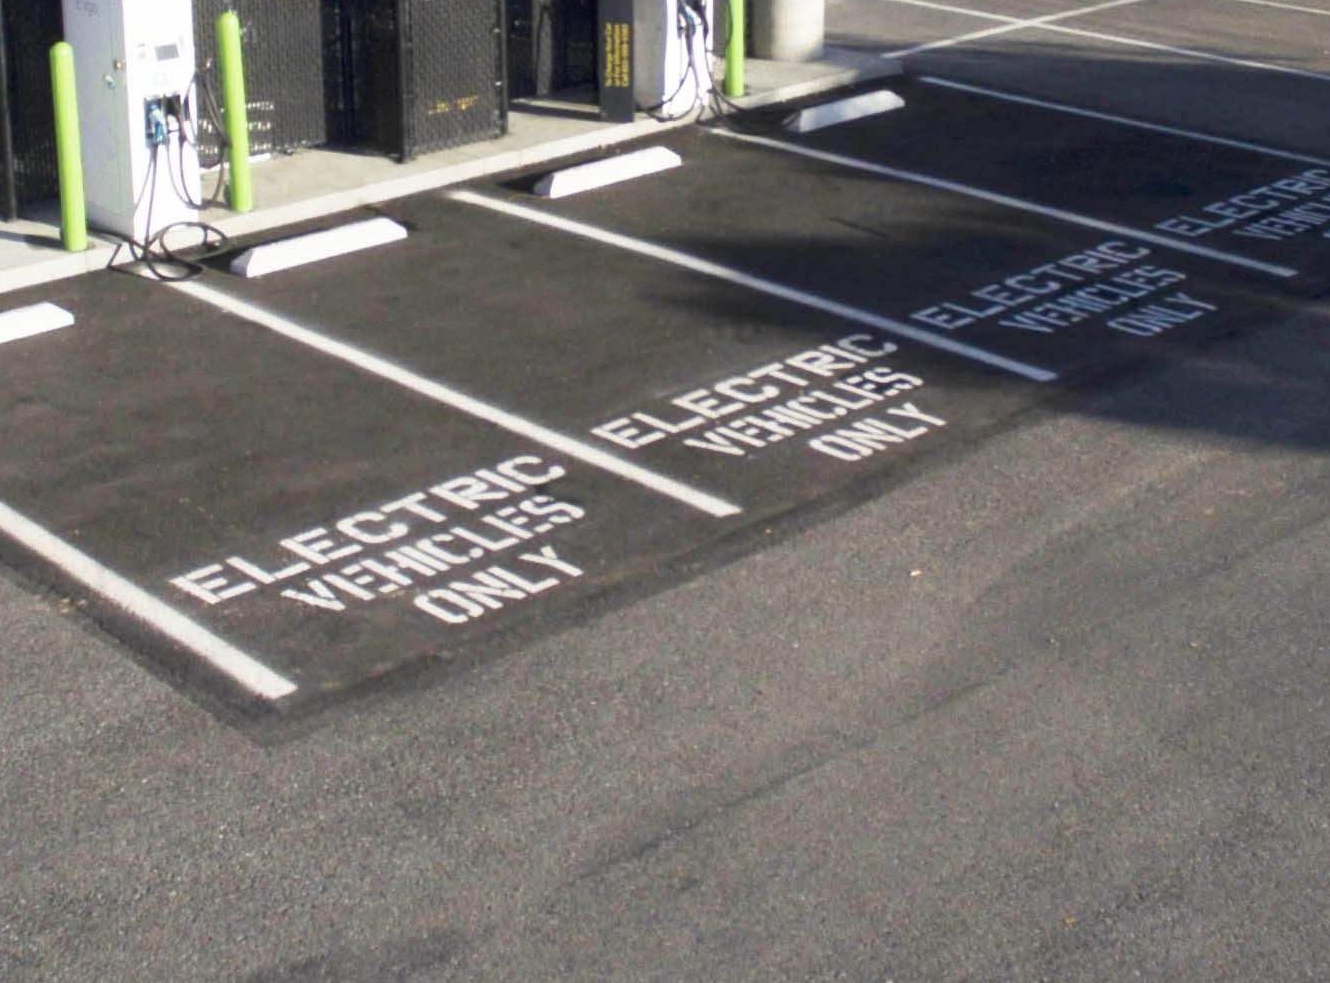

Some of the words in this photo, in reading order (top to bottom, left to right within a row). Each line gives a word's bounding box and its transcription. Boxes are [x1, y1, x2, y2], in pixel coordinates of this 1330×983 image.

[908, 240, 1151, 330] ELECTRIC
[997, 266, 1187, 333] VEHICLES
[1106, 291, 1217, 337] ONLY
[590, 333, 898, 449] ELECTRIC
[682, 367, 924, 456] VEHICLES
[808, 402, 948, 462] ONLY
[169, 454, 566, 605] ELECTRIC
[280, 495, 585, 612] VEHICLES
[412, 545, 584, 624] ONLY
